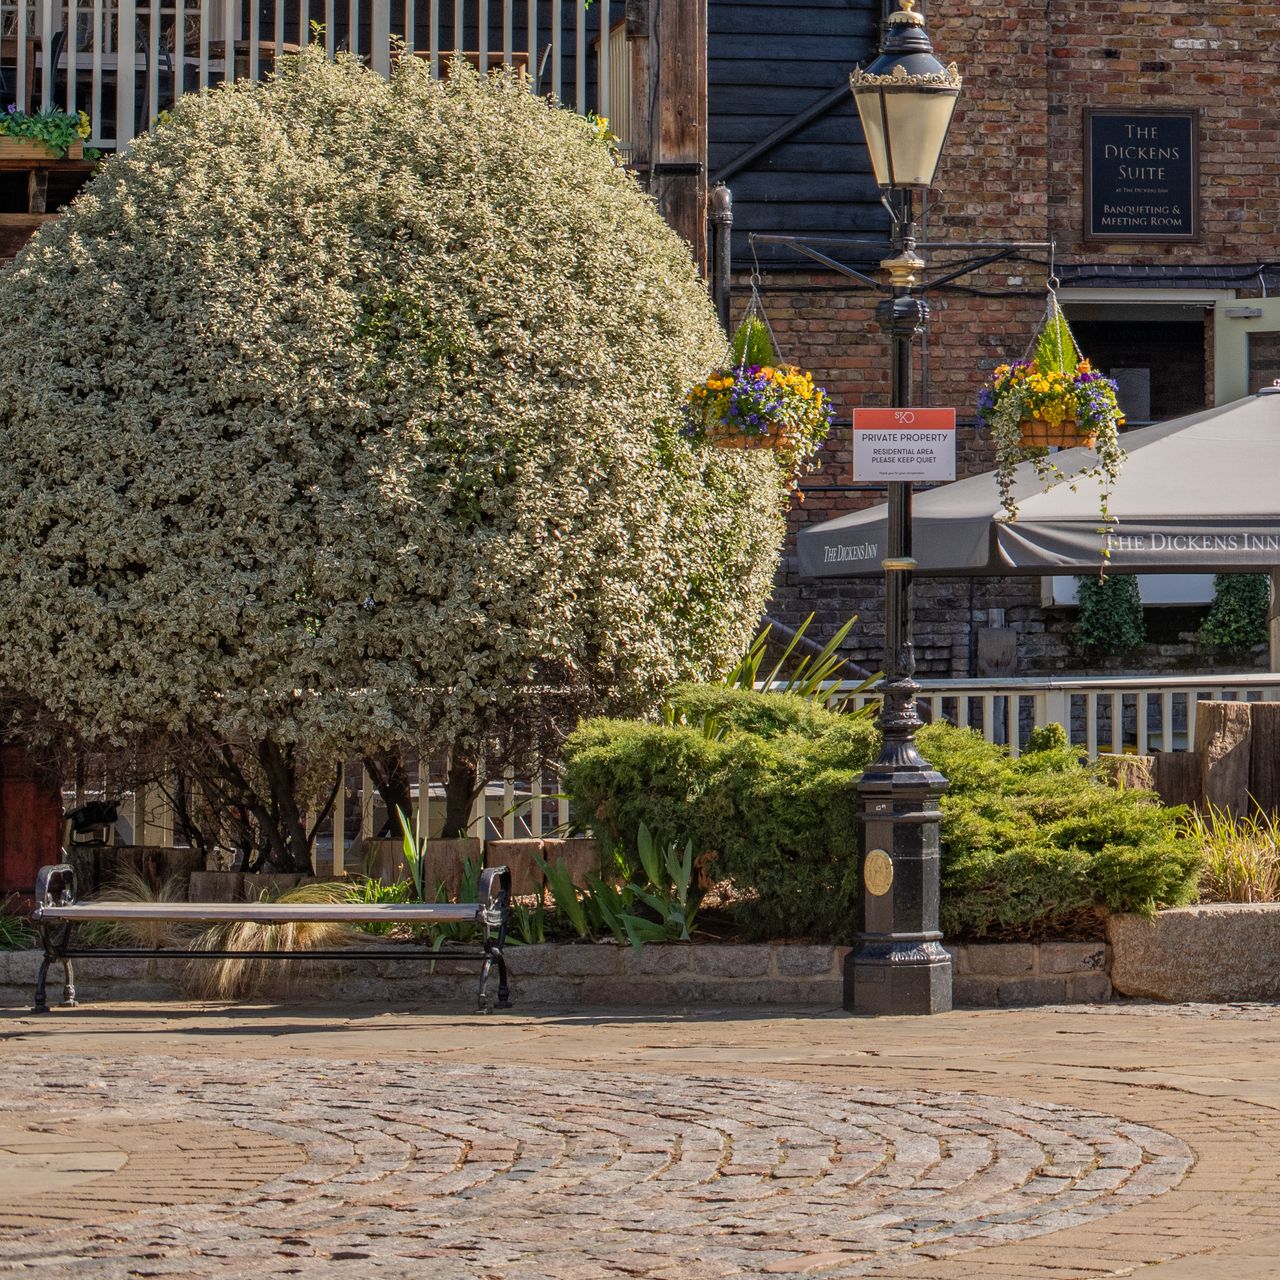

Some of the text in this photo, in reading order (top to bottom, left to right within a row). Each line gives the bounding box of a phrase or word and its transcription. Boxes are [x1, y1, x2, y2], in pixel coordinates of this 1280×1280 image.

[1125, 125, 1158, 139] THE
[1104, 144, 1179, 160] DICKENS
[1118, 165, 1166, 180] SUITE
[1104, 204, 1181, 215] BANQUETING &
[1101, 217, 1182, 226] MEETING ROOM
[862, 433, 948, 442] PRIVATE PROPERTY
[871, 456, 936, 464] PLEASE KEEP QUIET
[1101, 532, 1280, 551] THE DICKENS INN
[824, 542, 878, 562] THE DICKENS INN
